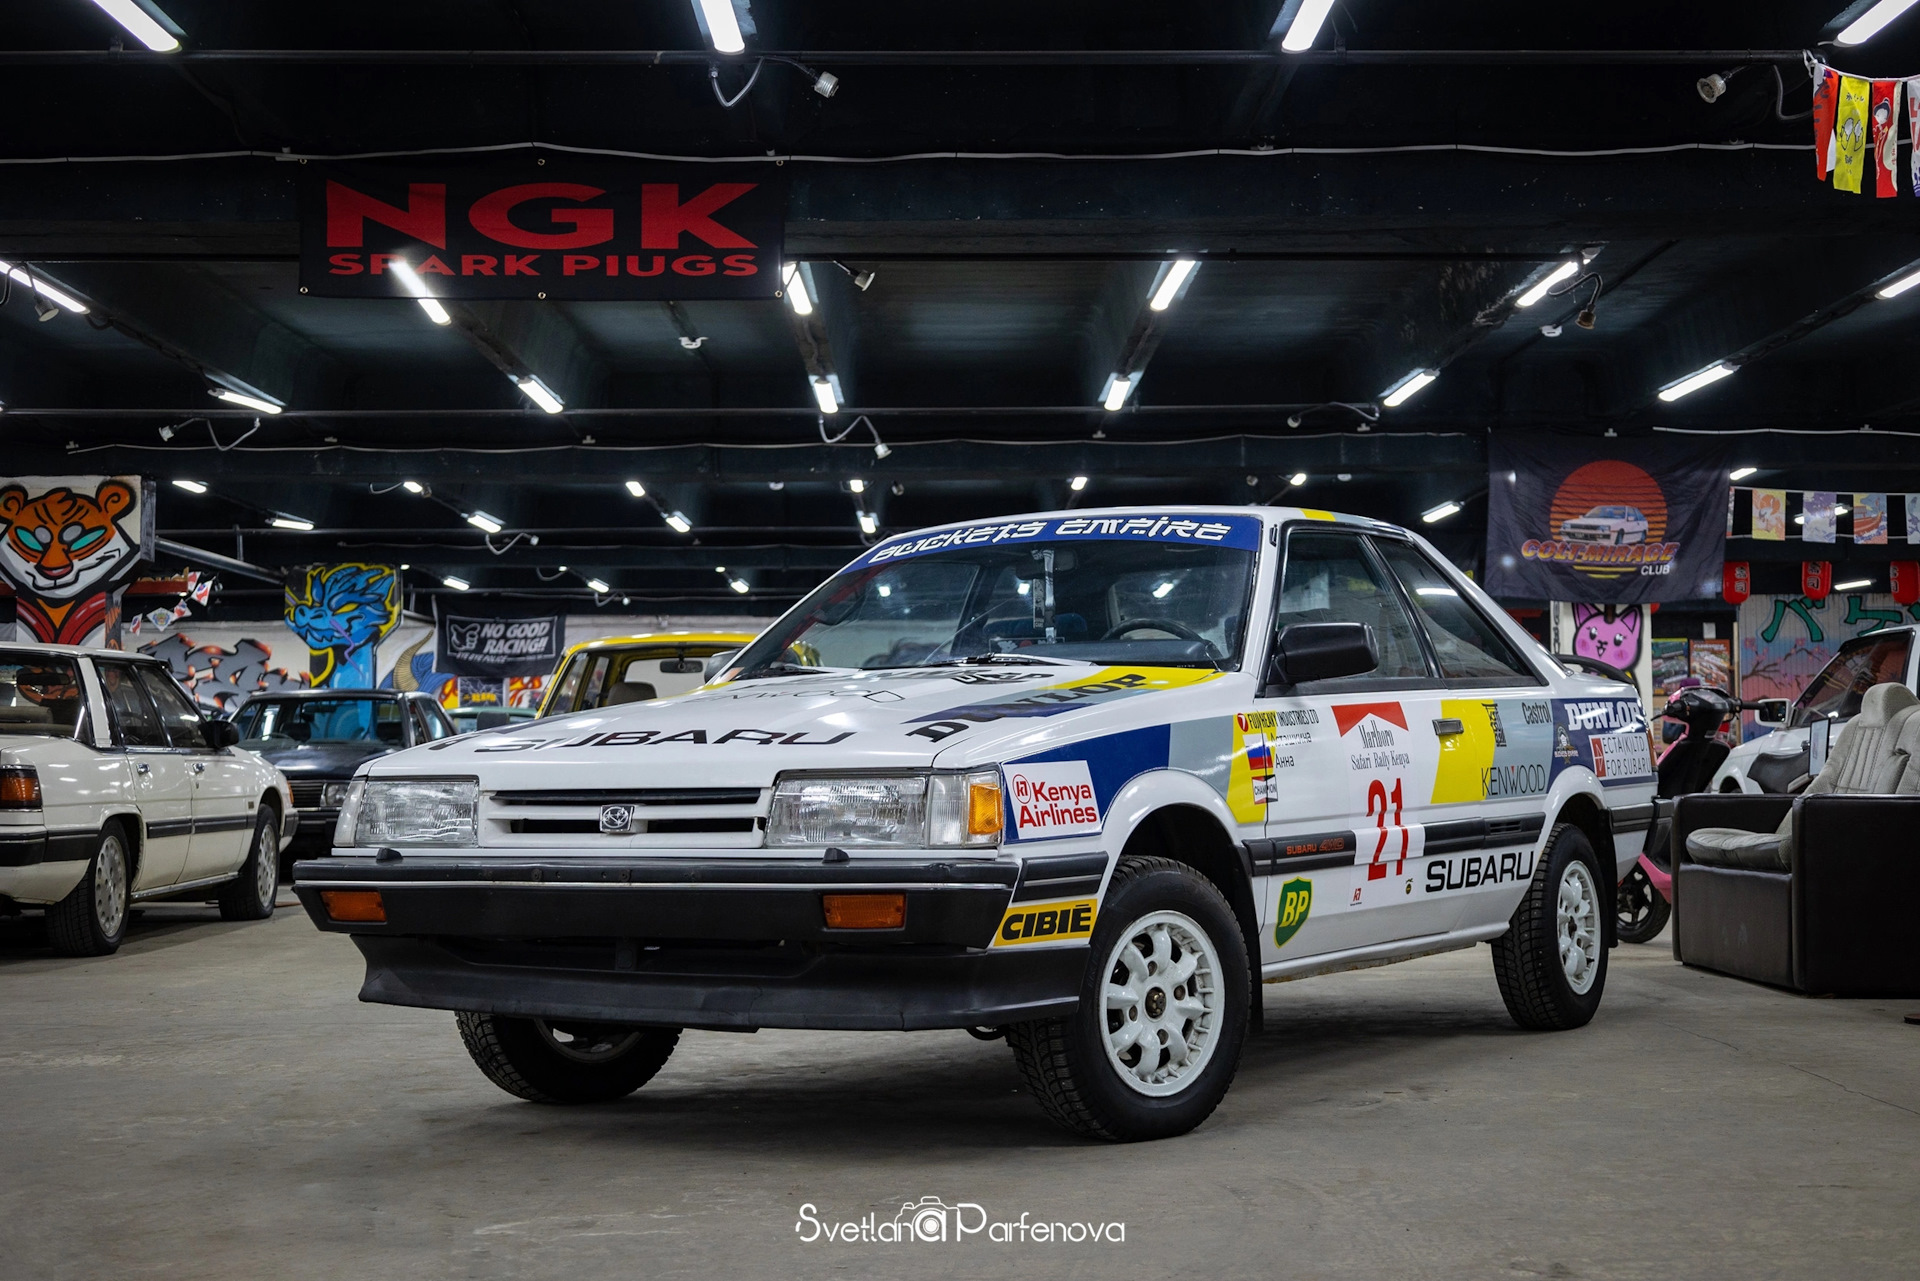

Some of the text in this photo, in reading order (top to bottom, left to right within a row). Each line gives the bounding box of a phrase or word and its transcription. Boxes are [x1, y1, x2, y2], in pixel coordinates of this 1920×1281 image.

[326, 179, 760, 250] NGK
[328, 253, 541, 276] SPARK
[867, 515, 1232, 565] BUCKETS EMPIRE
[1641, 564, 1671, 576] CLUB
[480, 621, 551, 638] NO GOOD
[483, 637, 548, 654] RACING!!
[906, 674, 1148, 743] DUNLOP
[1277, 710, 1309, 727] INDUSTRIES
[1307, 708, 1320, 724] LTD
[1522, 702, 1552, 725] Castrol
[474, 729, 858, 752] SUBARU
[1358, 720, 1395, 749] Marlboro
[1275, 754, 1295, 769] Анна
[1351, 750, 1411, 771] Safari Rally Kenya
[1606, 760, 1622, 777] FOR
[1481, 764, 1546, 797] KENWOOD
[1031, 781, 1092, 806] Kenya
[1019, 802, 1097, 829] Airlines
[1366, 777, 1409, 881] 21
[1286, 838, 1345, 855] SUBARU 4WD
[1425, 850, 1535, 893] SUBARU
[1279, 891, 1309, 928] BP
